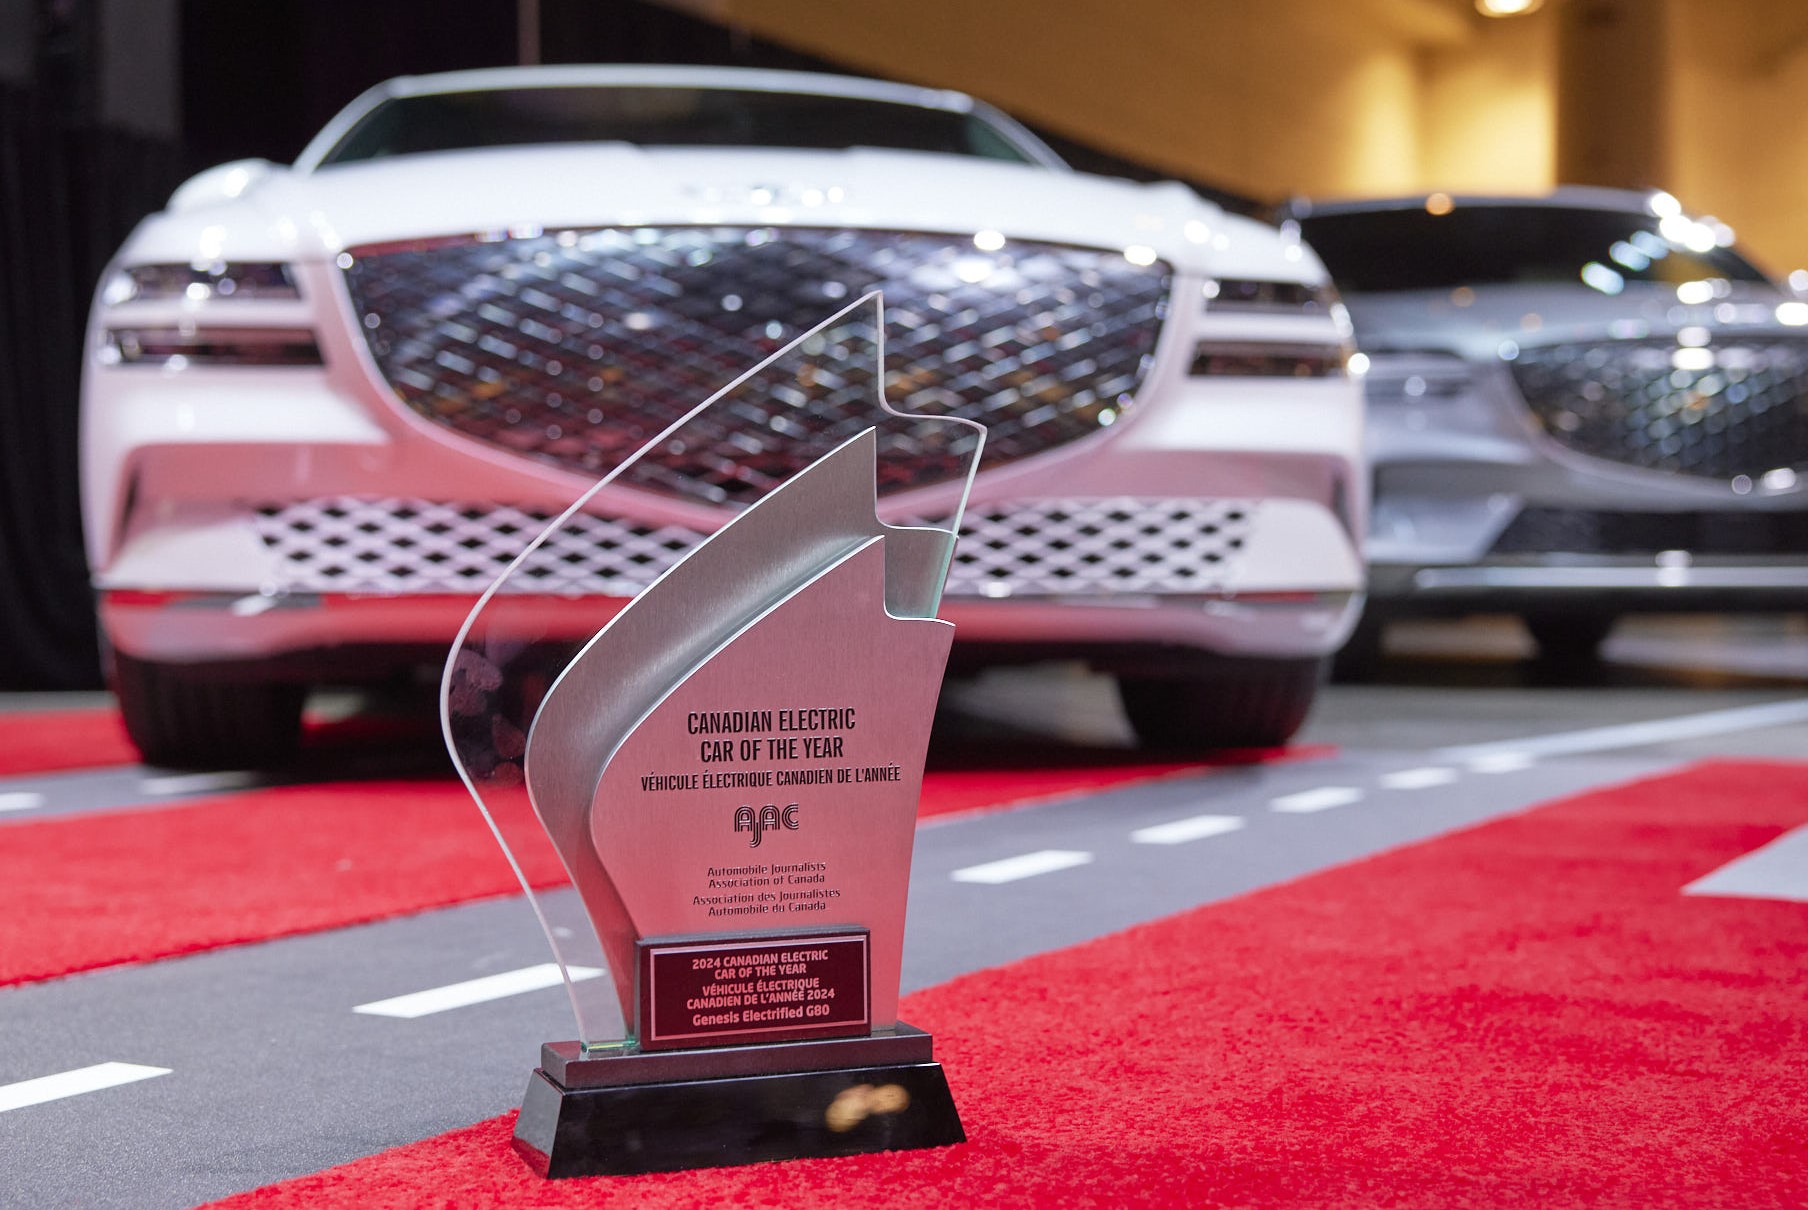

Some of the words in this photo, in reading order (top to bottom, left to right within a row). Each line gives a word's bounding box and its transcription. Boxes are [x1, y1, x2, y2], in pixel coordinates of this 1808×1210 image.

[687, 711, 772, 735] CANADIAN
[779, 708, 856, 732] ELECTRIC
[700, 740, 734, 763] CAR
[740, 739, 762, 761] OF
[768, 738, 798, 760] THE
[803, 736, 844, 758] YEAR
[641, 771, 699, 791] VÉHICULE
[703, 770, 772, 789] ÉLECTRIQUE
[776, 768, 833, 786] CANADIEN
[837, 768, 852, 783] DE
[855, 762, 901, 782] L'ANNÉE
[734, 803, 800, 848] AJAC
[707, 864, 768, 877] Automobile
[771, 862, 826, 875] Journalists
[708, 876, 770, 889] Association
[773, 875, 784, 886] of
[787, 873, 825, 885] Canada
[693, 893, 754, 905] Association
[757, 891, 776, 902] des
[779, 888, 841, 901] Journalistes
[708, 904, 769, 917] Automobile
[772, 903, 785, 913] du
[788, 901, 826, 912] Canada
[692, 957, 721, 970] 2024
[723, 953, 778, 967] CANADIAN
[781, 949, 829, 963] ELECTRIC
[714, 968, 736, 980] CAR
[738, 968, 752, 979] OF
[755, 966, 776, 977] THE
[778, 963, 807, 976] YEAR
[702, 982, 754, 997] VÉHICULE
[756, 977, 820, 993] ÉLECTRIQUE
[686, 995, 741, 1010] CANADIEN
[744, 994, 758, 1005] DE
[760, 988, 805, 1004] L'ANNÉE
[807, 988, 835, 1000] 2024
[692, 1011, 740, 1027] Genesis
[742, 1006, 804, 1022] Electrified
[806, 1004, 830, 1016] G80
